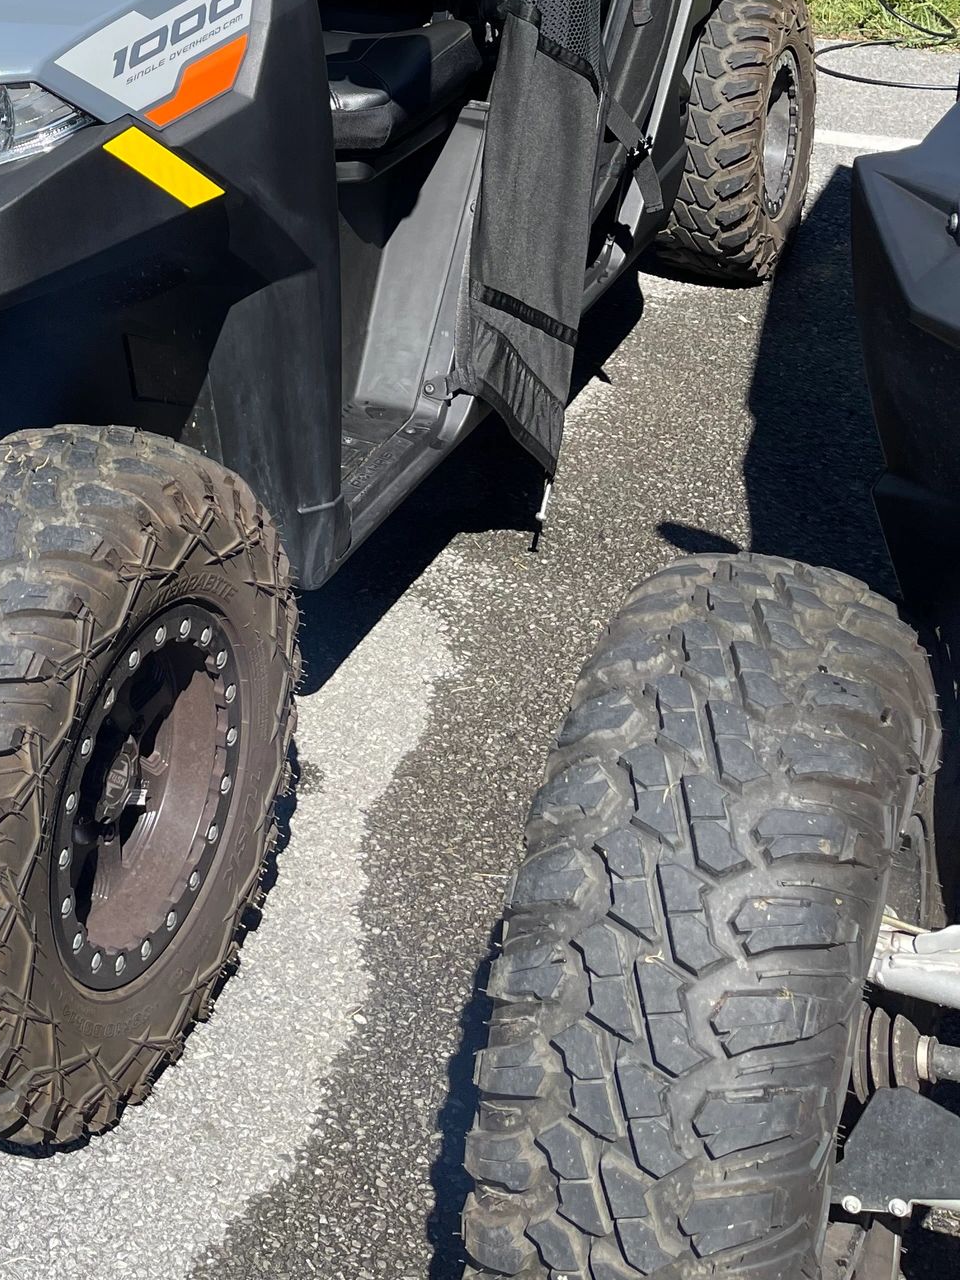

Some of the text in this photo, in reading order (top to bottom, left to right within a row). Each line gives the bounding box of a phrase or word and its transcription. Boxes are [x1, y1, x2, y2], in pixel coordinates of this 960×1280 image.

[125, 13, 244, 85] SINGLE OVERHEAD CAM
